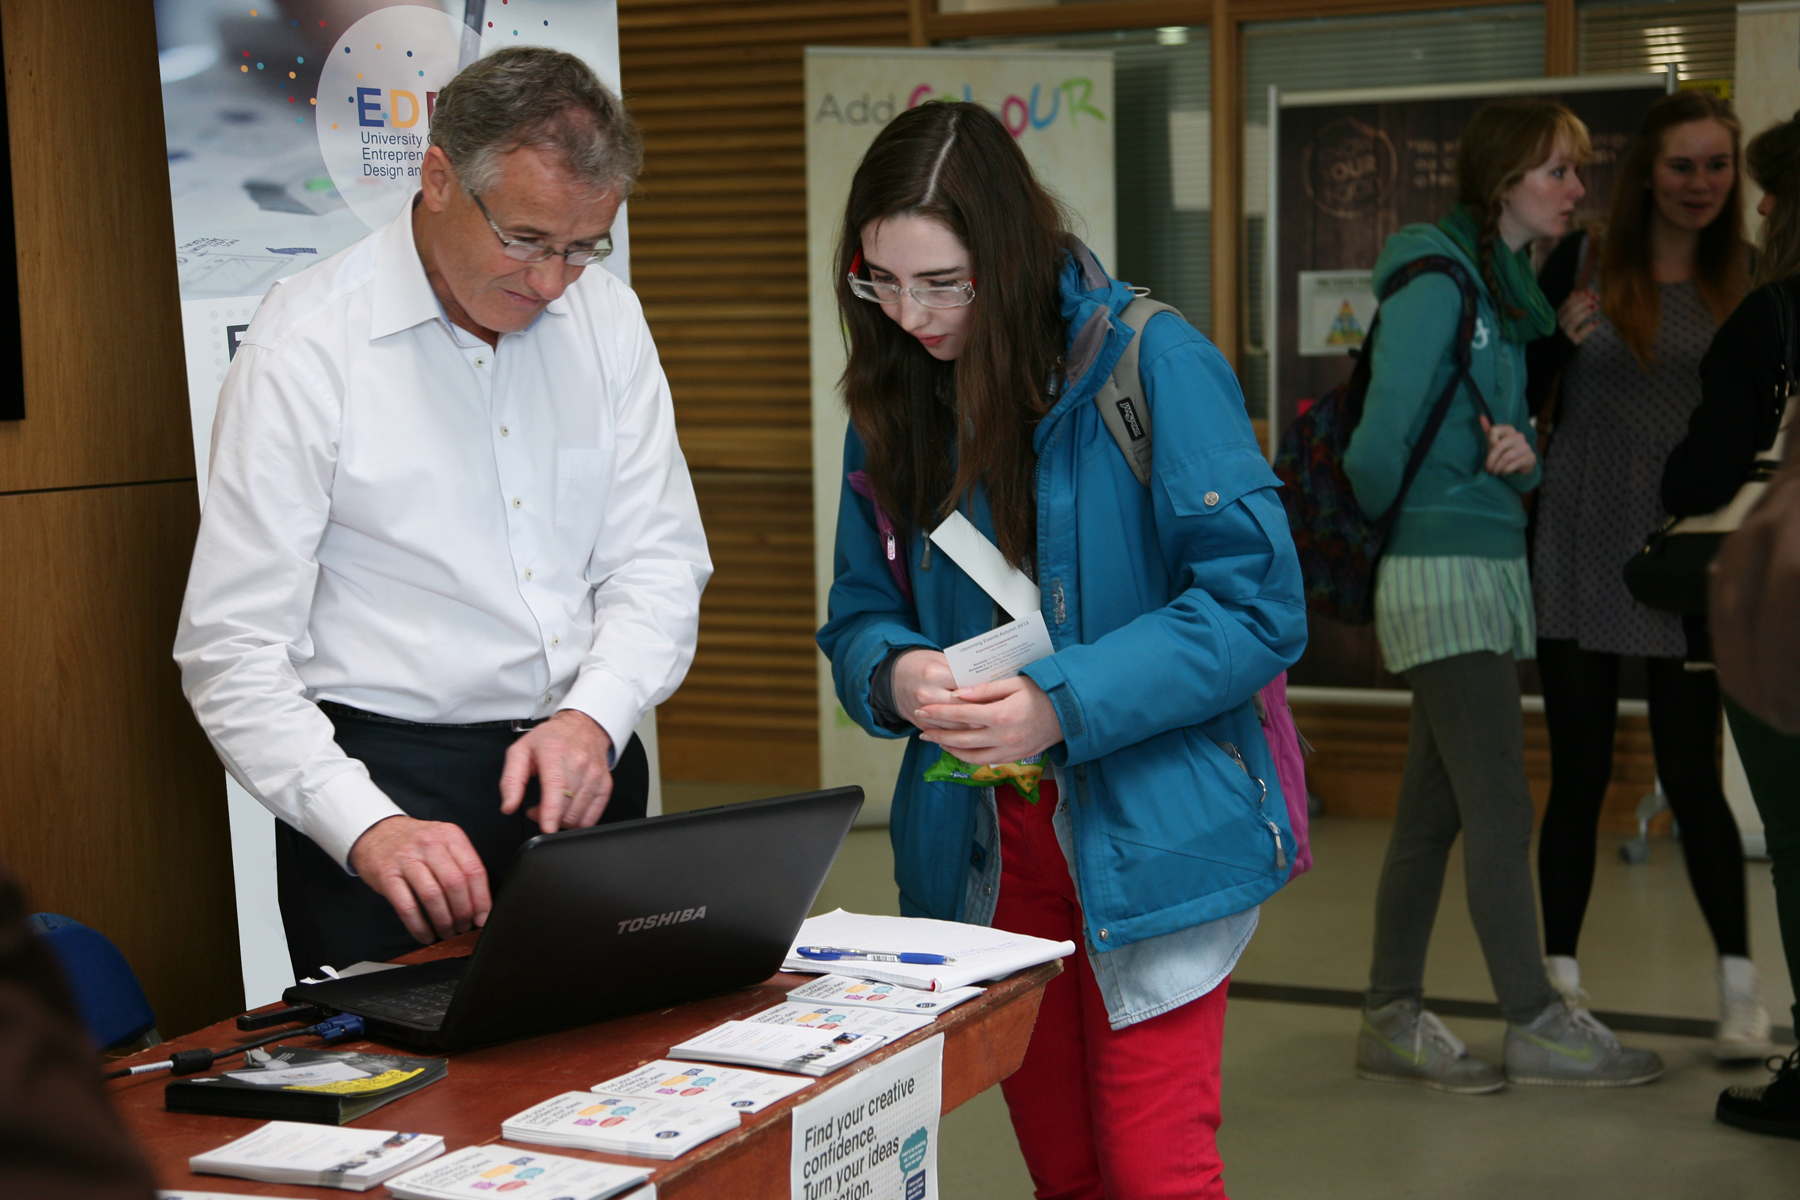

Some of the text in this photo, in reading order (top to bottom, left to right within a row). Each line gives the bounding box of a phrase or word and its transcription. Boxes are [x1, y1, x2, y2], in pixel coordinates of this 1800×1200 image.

[815, 76, 1106, 138] Add COUR
[361, 131, 423, 148] University
[362, 147, 424, 163] Entrepren
[363, 163, 422, 180] Design an
[983, 634, 999, 643] Events
[999, 627, 1017, 637] Autumn
[1017, 621, 1029, 629] 2013
[617, 905, 707, 935] TOSHIBA
[805, 1077, 915, 1152] Find your creative
[803, 1126, 877, 1179] confidence.
[803, 1175, 832, 1200] Turn
[836, 1156, 865, 1194] your
[868, 1136, 900, 1169] ideas
